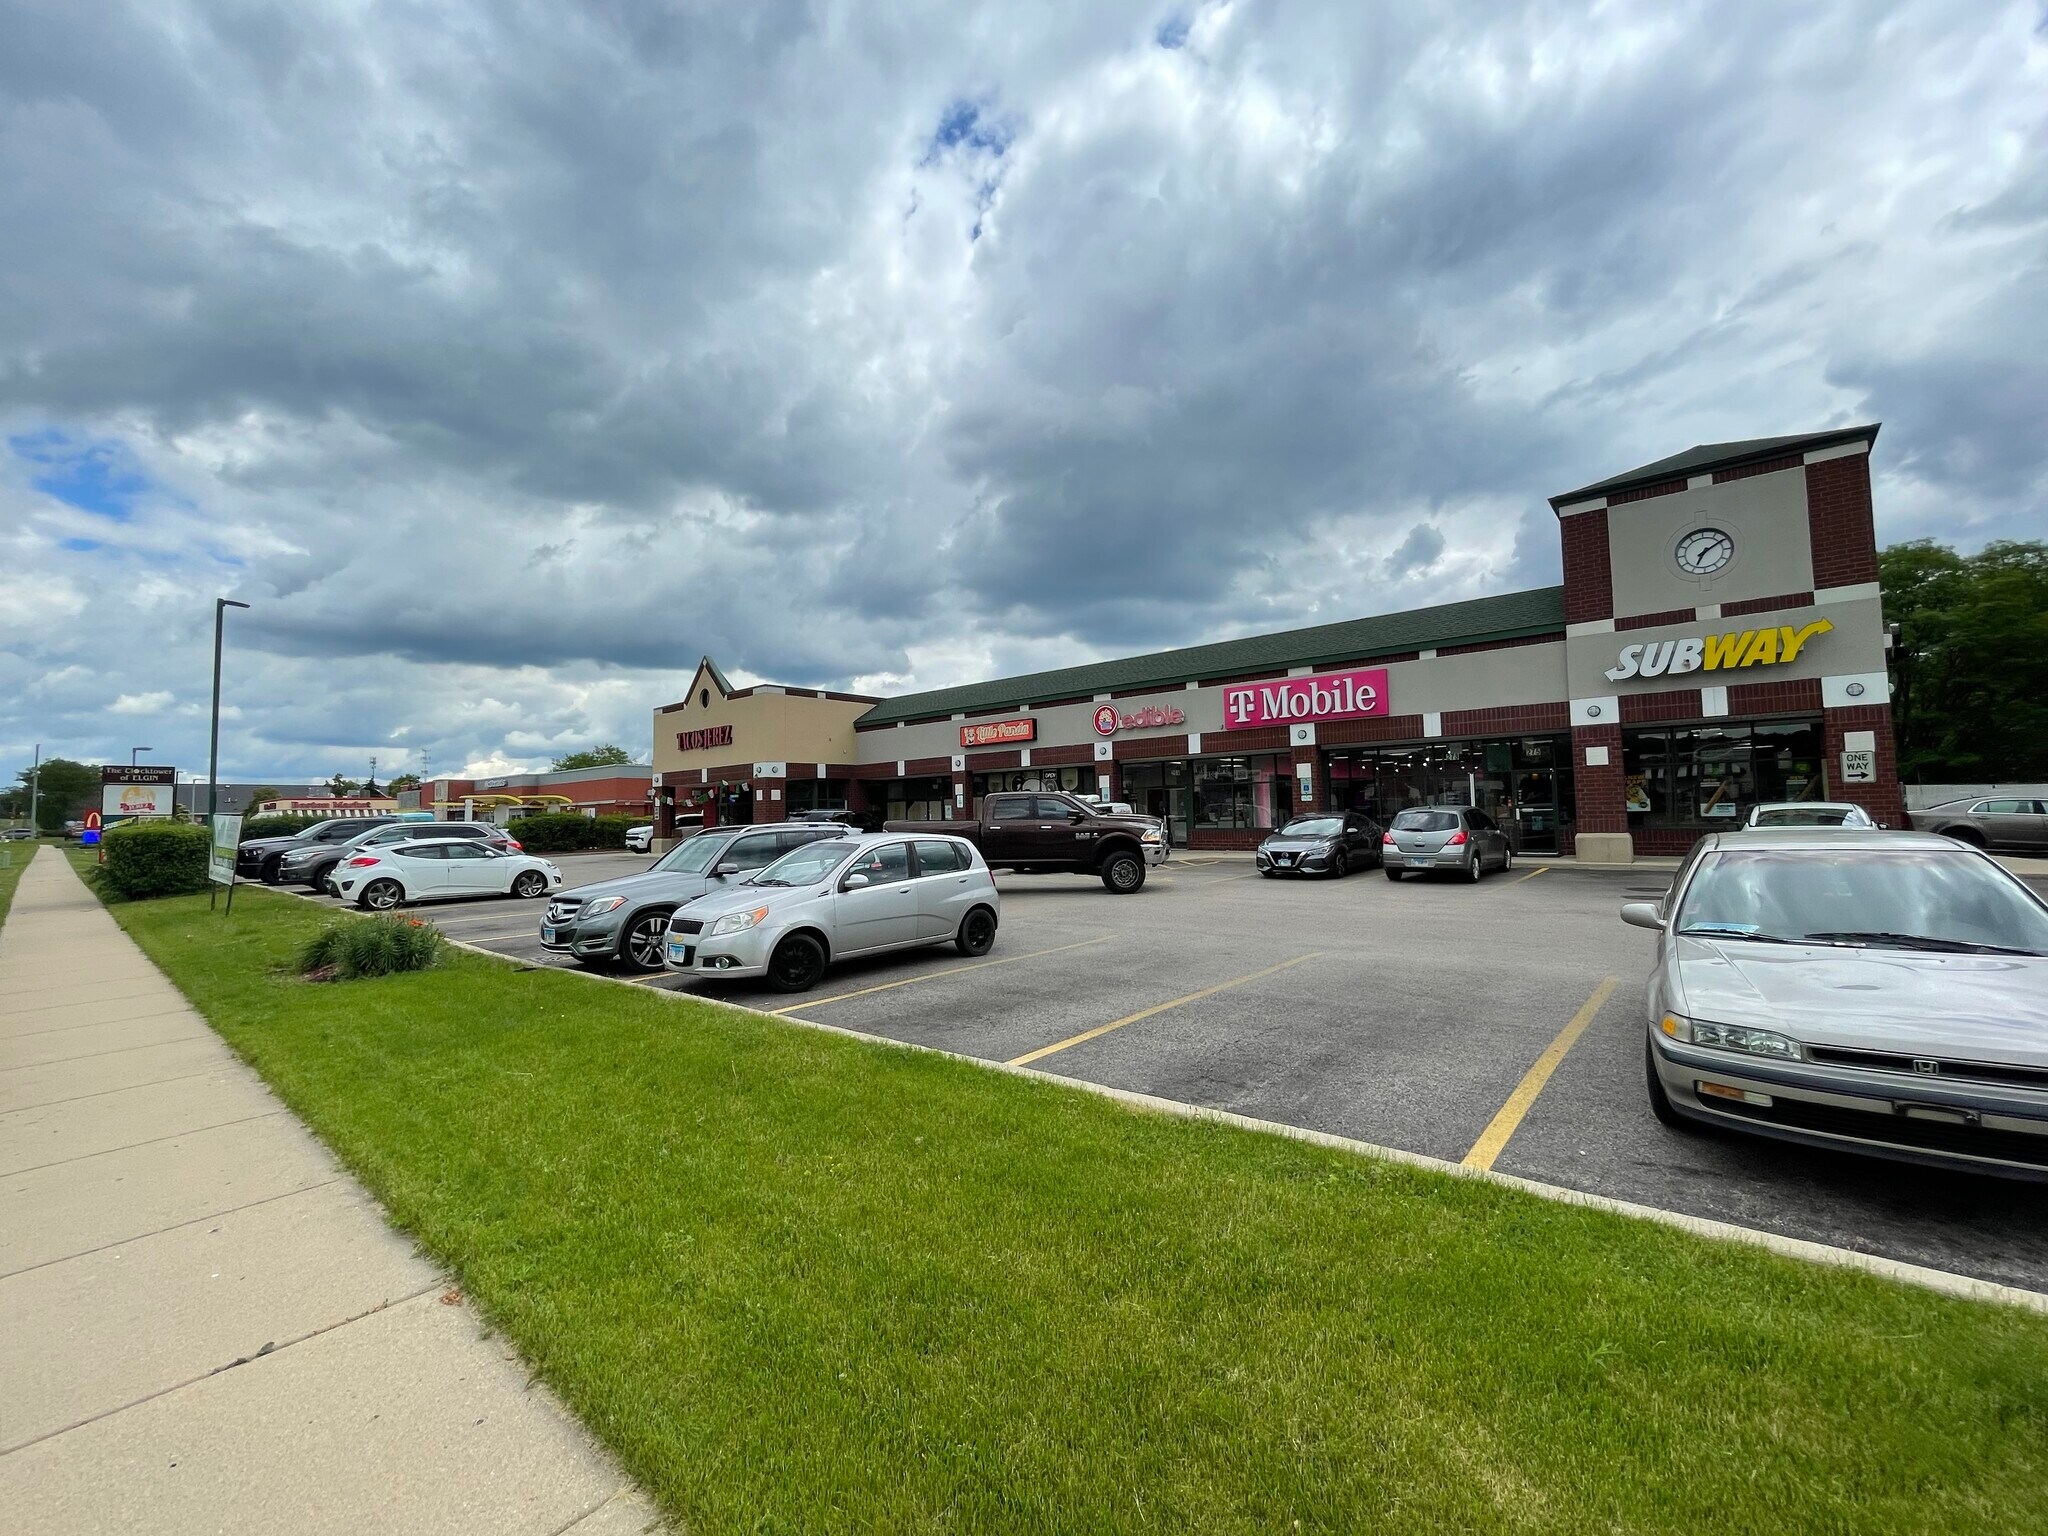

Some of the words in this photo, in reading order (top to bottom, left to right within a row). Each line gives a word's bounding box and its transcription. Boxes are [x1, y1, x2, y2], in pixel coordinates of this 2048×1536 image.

[1604, 617, 1834, 682] SUBWAY
[1229, 690, 1255, 723] T
[1260, 677, 1377, 720] Mobile
[1122, 704, 1184, 730] edible
[976, 725, 998, 743] Little
[998, 722, 1029, 738] Panda
[1846, 753, 1869, 762] ONE
[1847, 762, 1870, 771] WAY
[291, 801, 330, 809] Boston
[332, 801, 372, 809] Market
